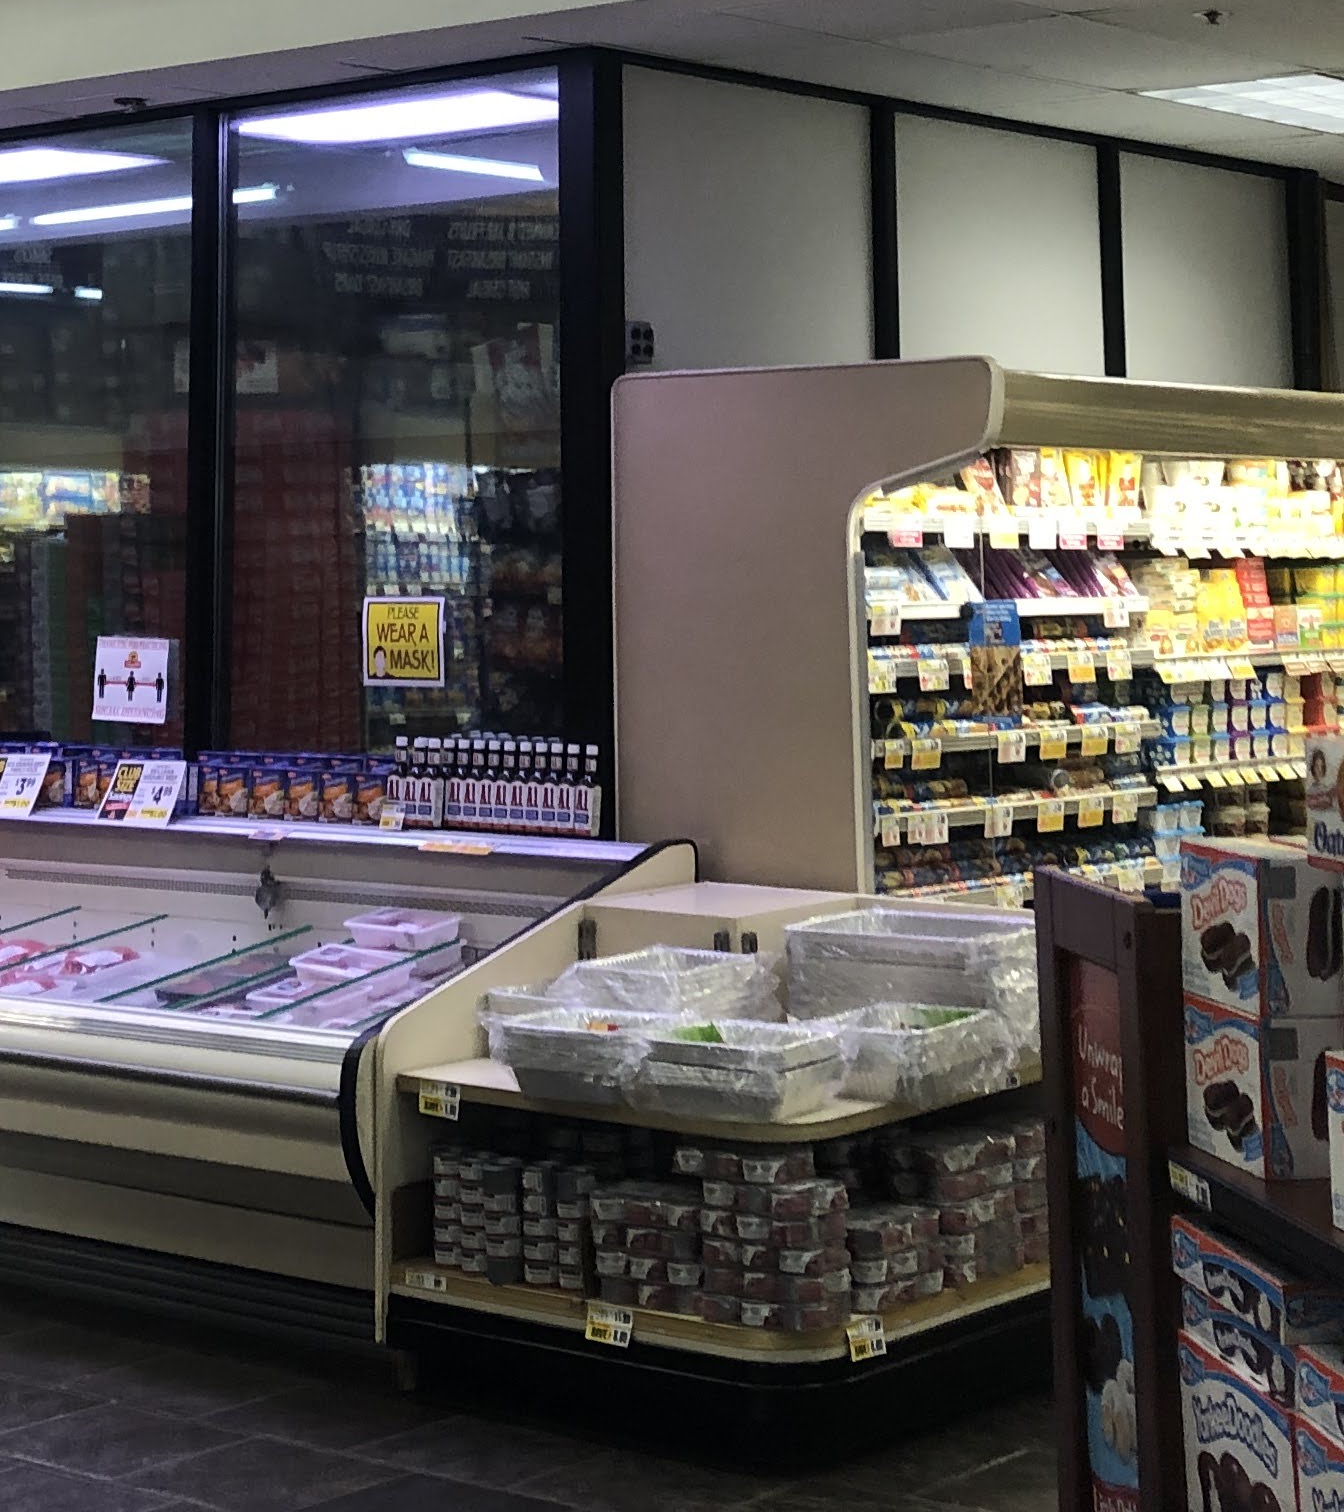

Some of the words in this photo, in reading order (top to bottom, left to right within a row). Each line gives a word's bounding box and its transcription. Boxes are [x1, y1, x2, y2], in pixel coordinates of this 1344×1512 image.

[387, 606, 420, 620] PLEASE
[376, 622, 417, 647] WEAR
[419, 622, 430, 643] A
[389, 648, 435, 674] MASK!
